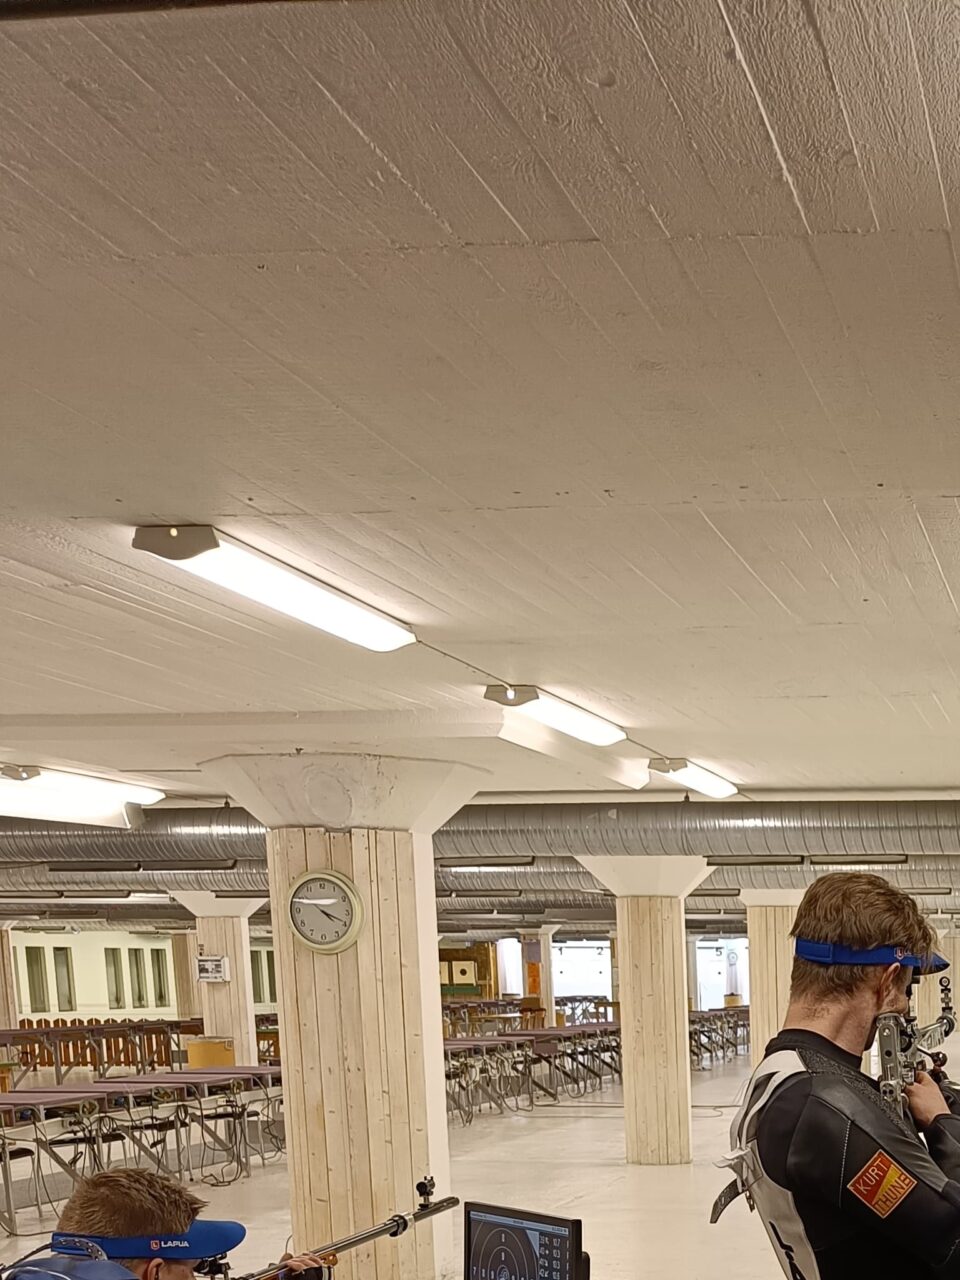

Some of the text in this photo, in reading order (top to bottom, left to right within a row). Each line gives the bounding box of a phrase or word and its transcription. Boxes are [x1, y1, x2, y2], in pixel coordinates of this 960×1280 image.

[715, 947, 723, 957] 5
[855, 1157, 888, 1195] KURT
[873, 1174, 913, 1215] THUNE
[161, 1240, 190, 1248] LAPUA
